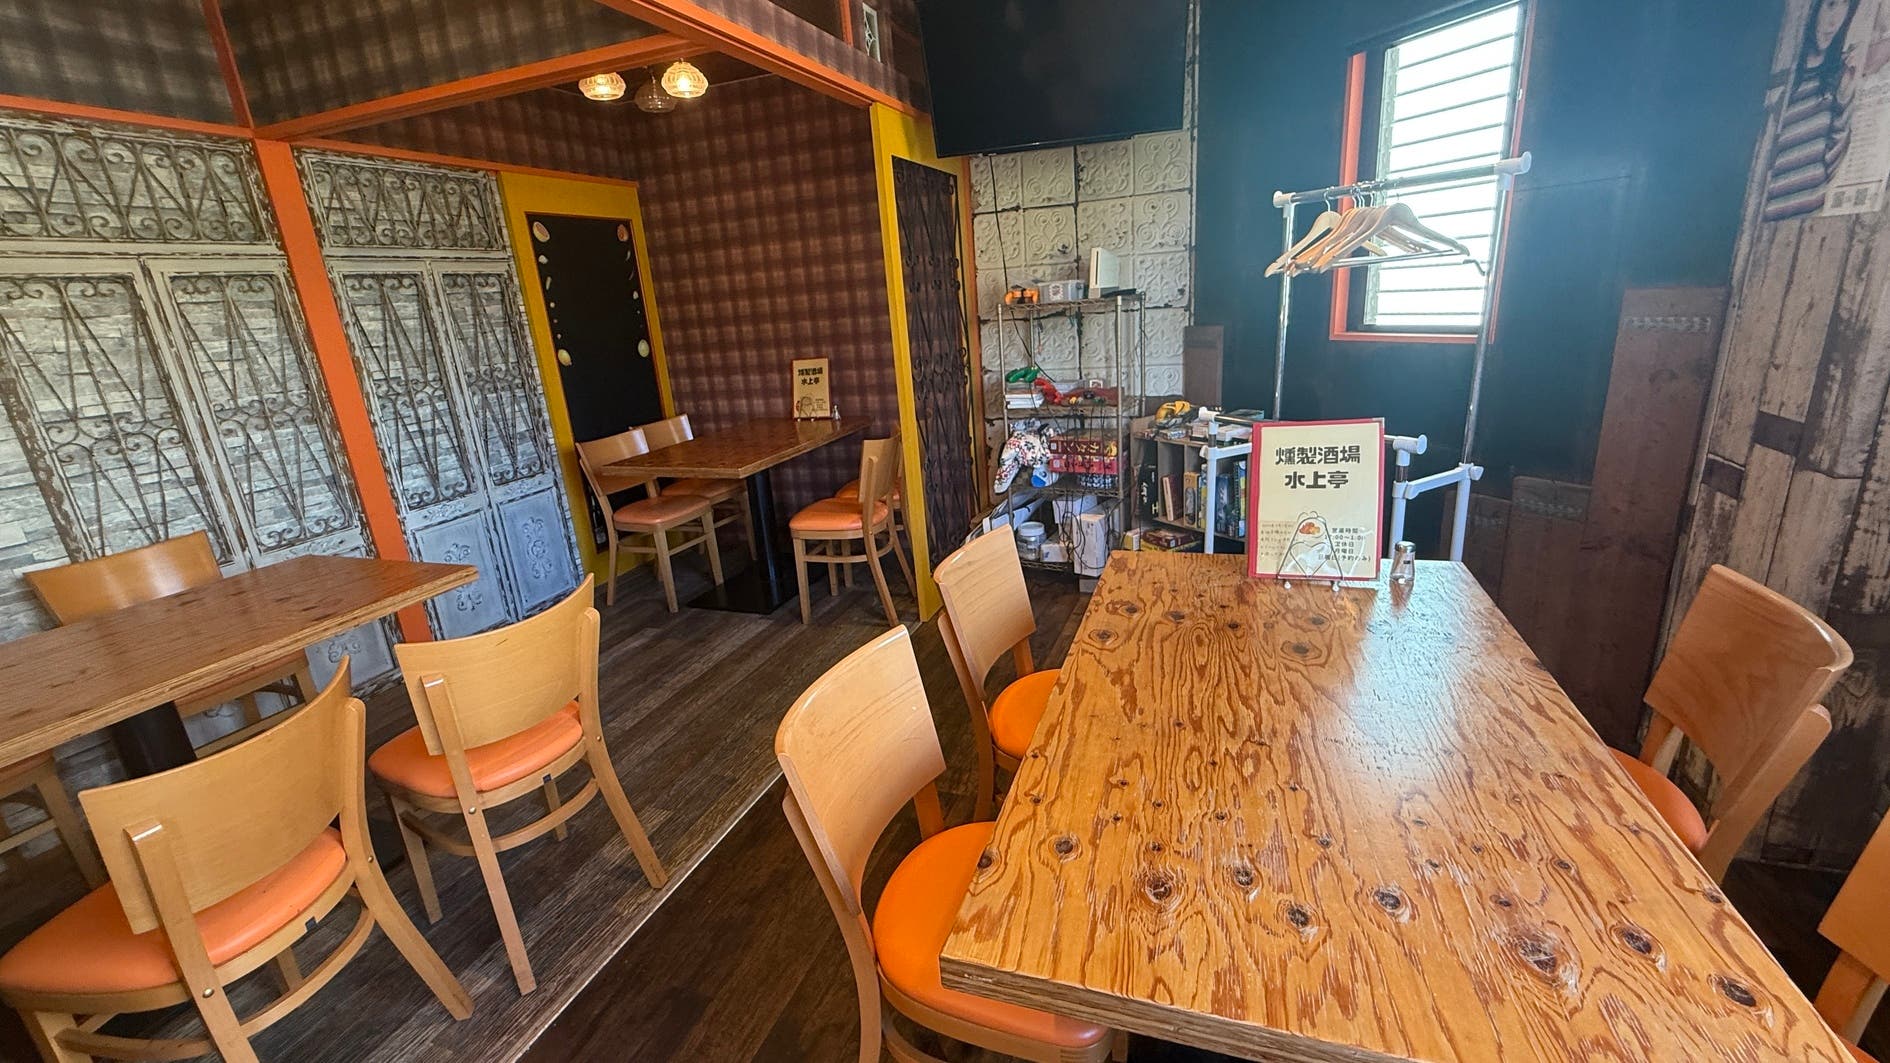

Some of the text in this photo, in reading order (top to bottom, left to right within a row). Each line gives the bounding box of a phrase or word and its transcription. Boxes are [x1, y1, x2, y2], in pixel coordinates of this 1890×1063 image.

[1275, 445, 1360, 465] 燻製酒場
[1285, 471, 1349, 489] 水上亭
